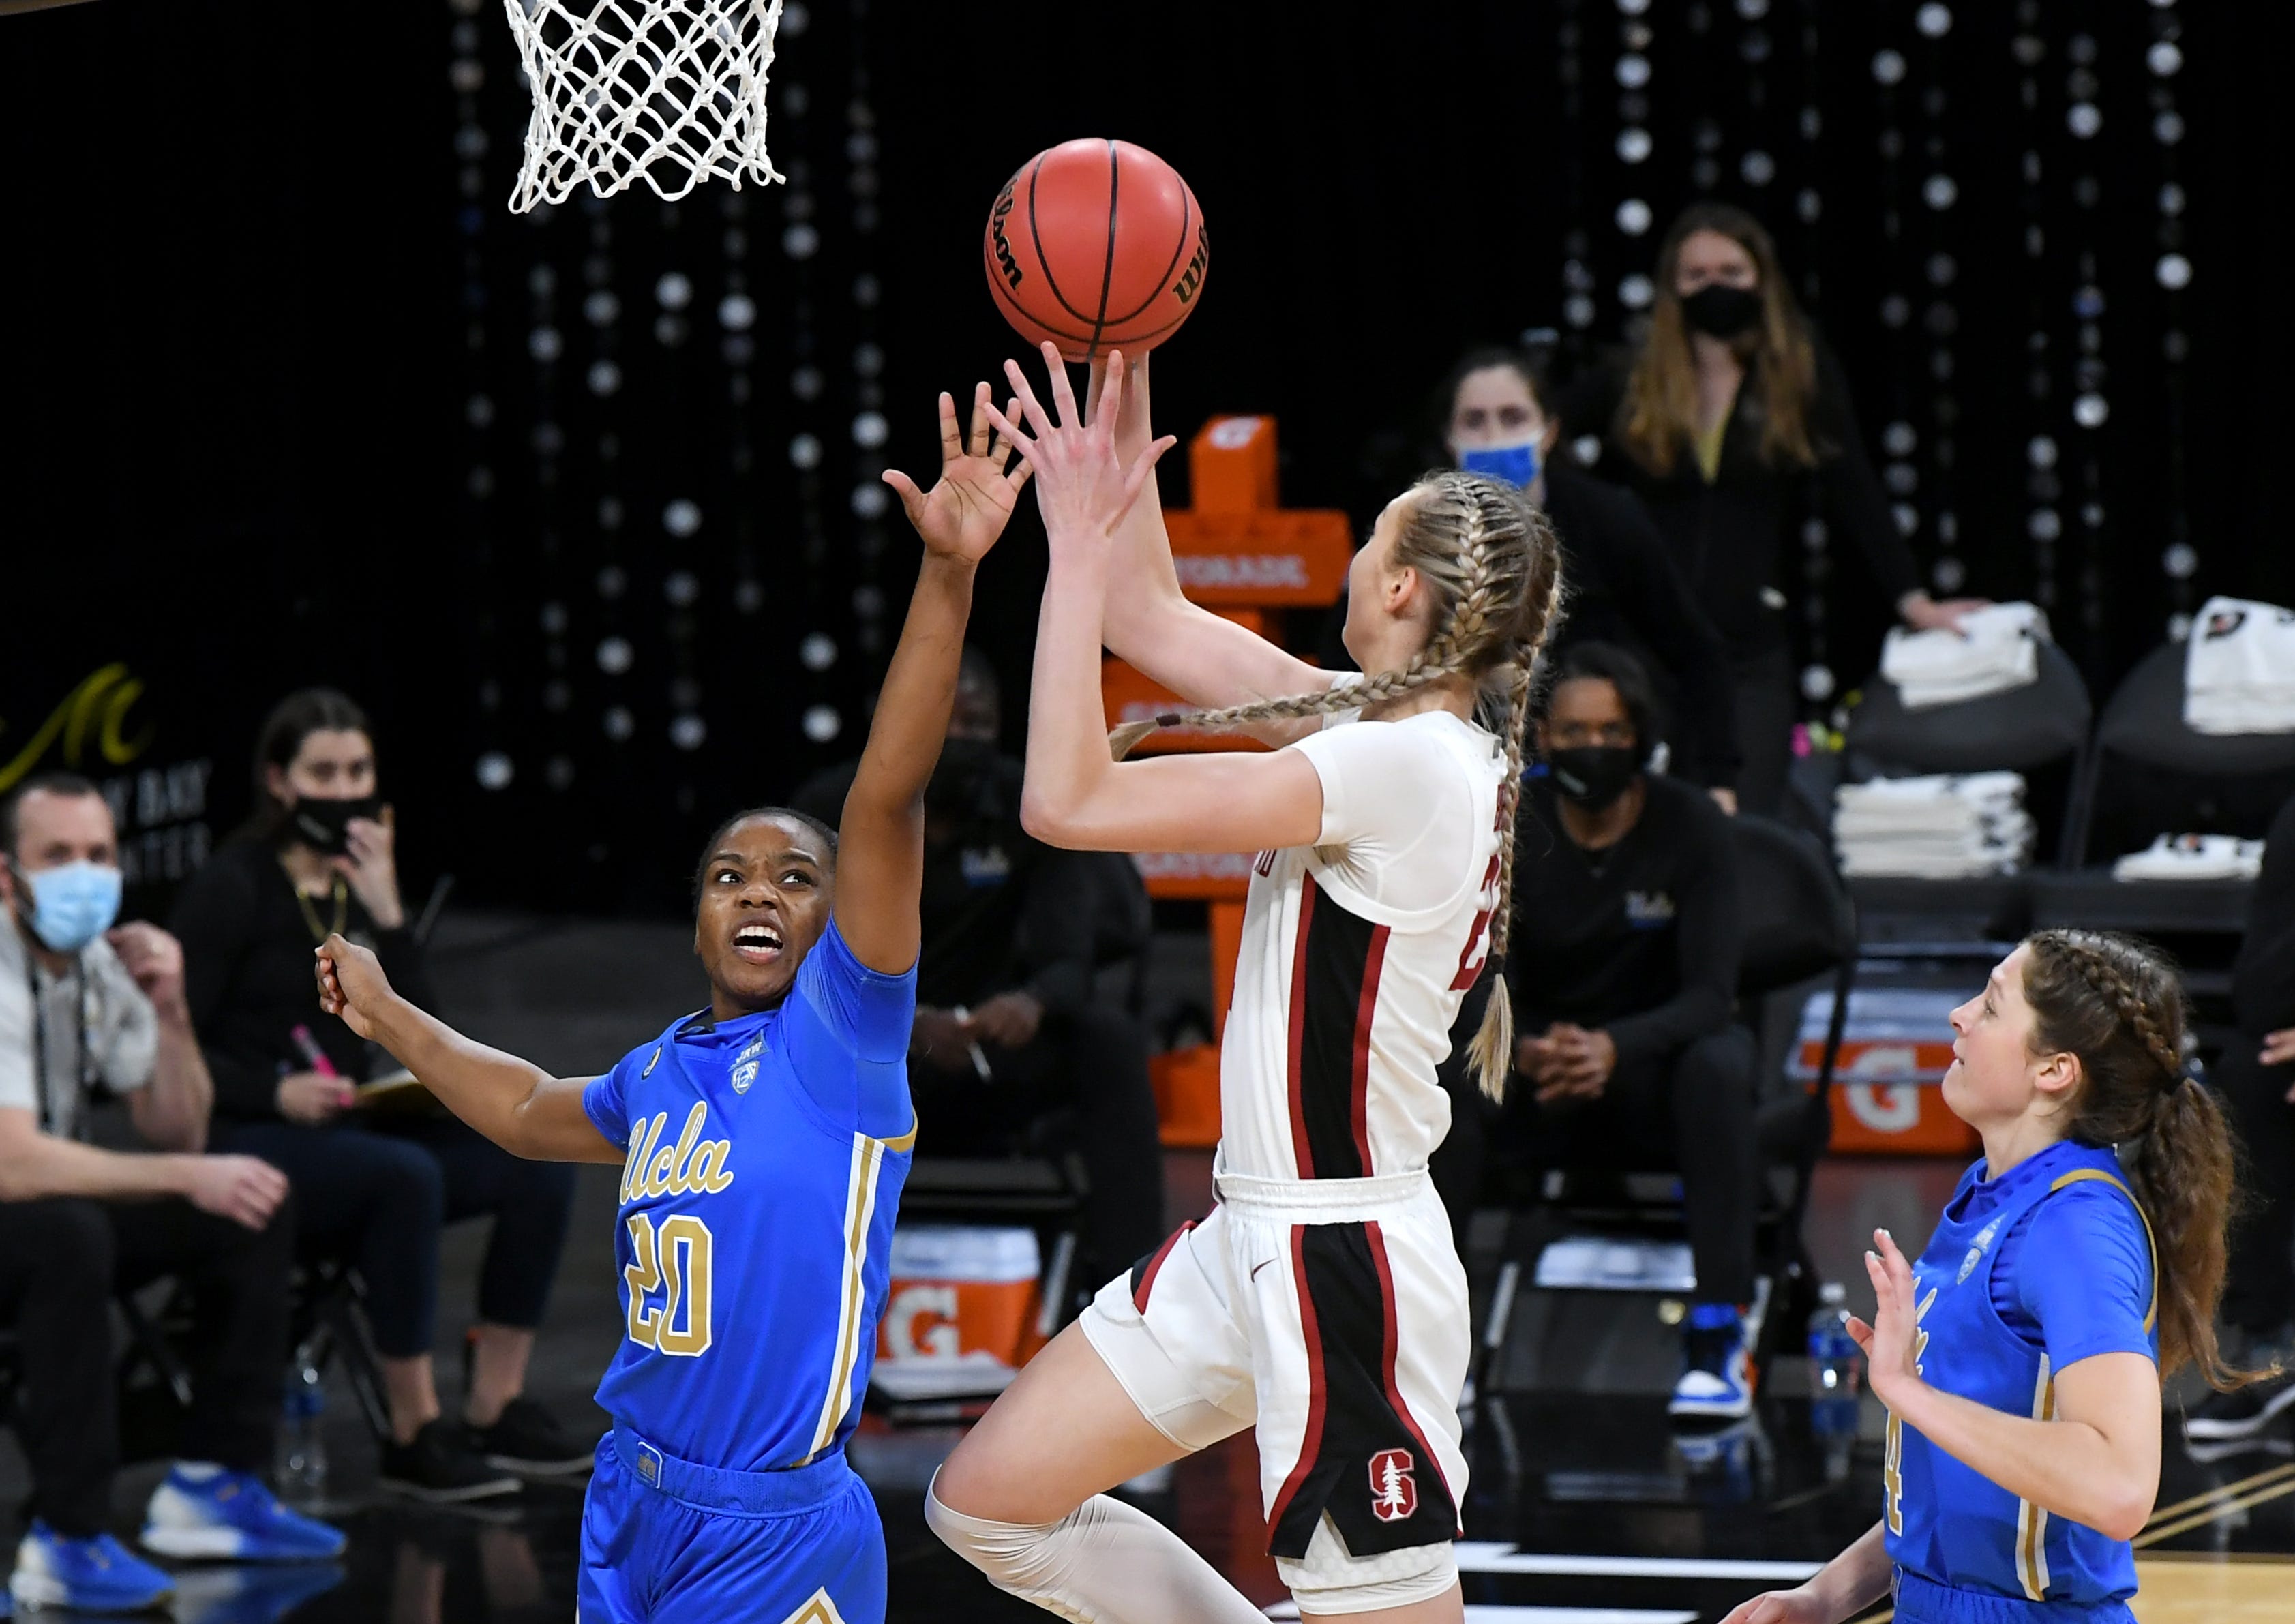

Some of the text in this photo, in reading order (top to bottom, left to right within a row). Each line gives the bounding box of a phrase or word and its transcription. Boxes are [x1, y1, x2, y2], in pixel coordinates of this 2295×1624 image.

[619, 1100, 734, 1205] Ucla
[624, 1212, 712, 1357] 20
[886, 1285, 957, 1363] G
